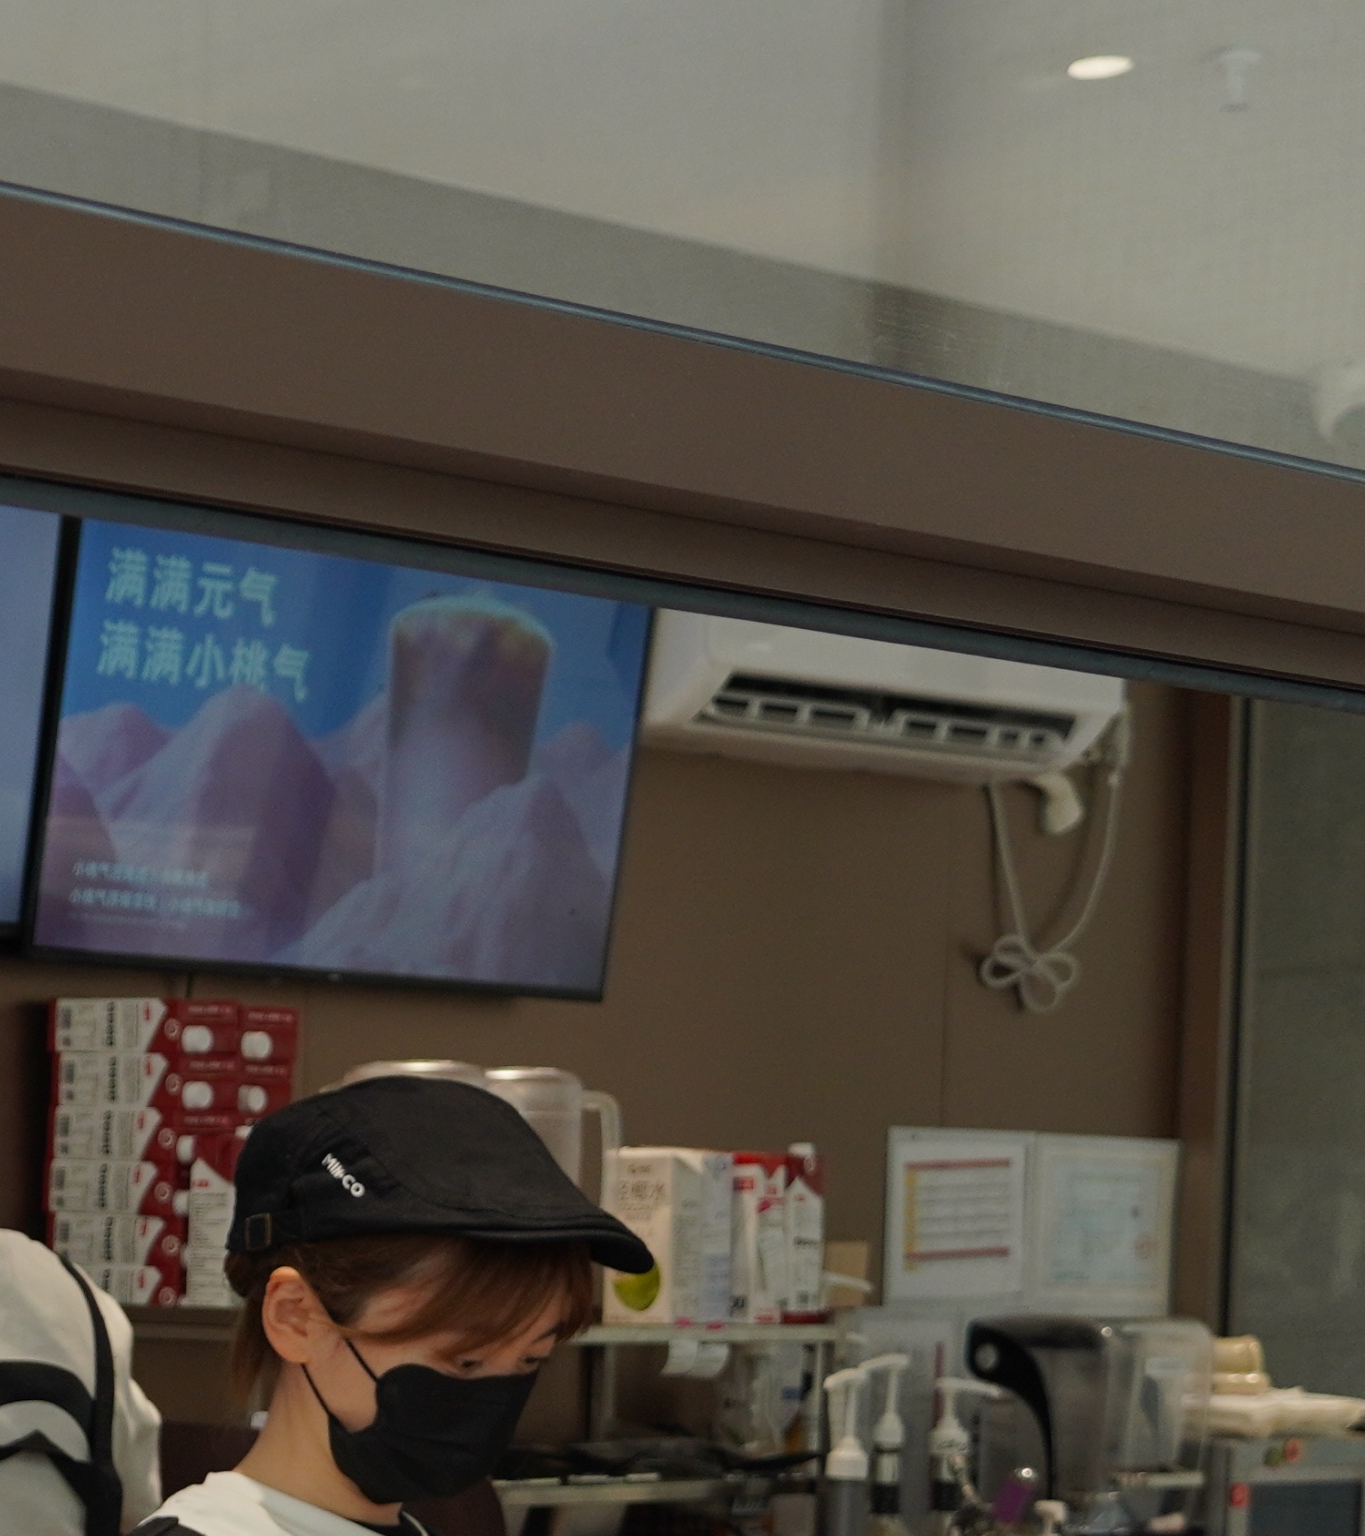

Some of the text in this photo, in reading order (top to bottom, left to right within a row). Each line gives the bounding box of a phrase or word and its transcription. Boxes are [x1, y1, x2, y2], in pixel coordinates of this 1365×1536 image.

[104, 546, 280, 629] 满满元气
[97, 619, 310, 704] 满满小桃气
